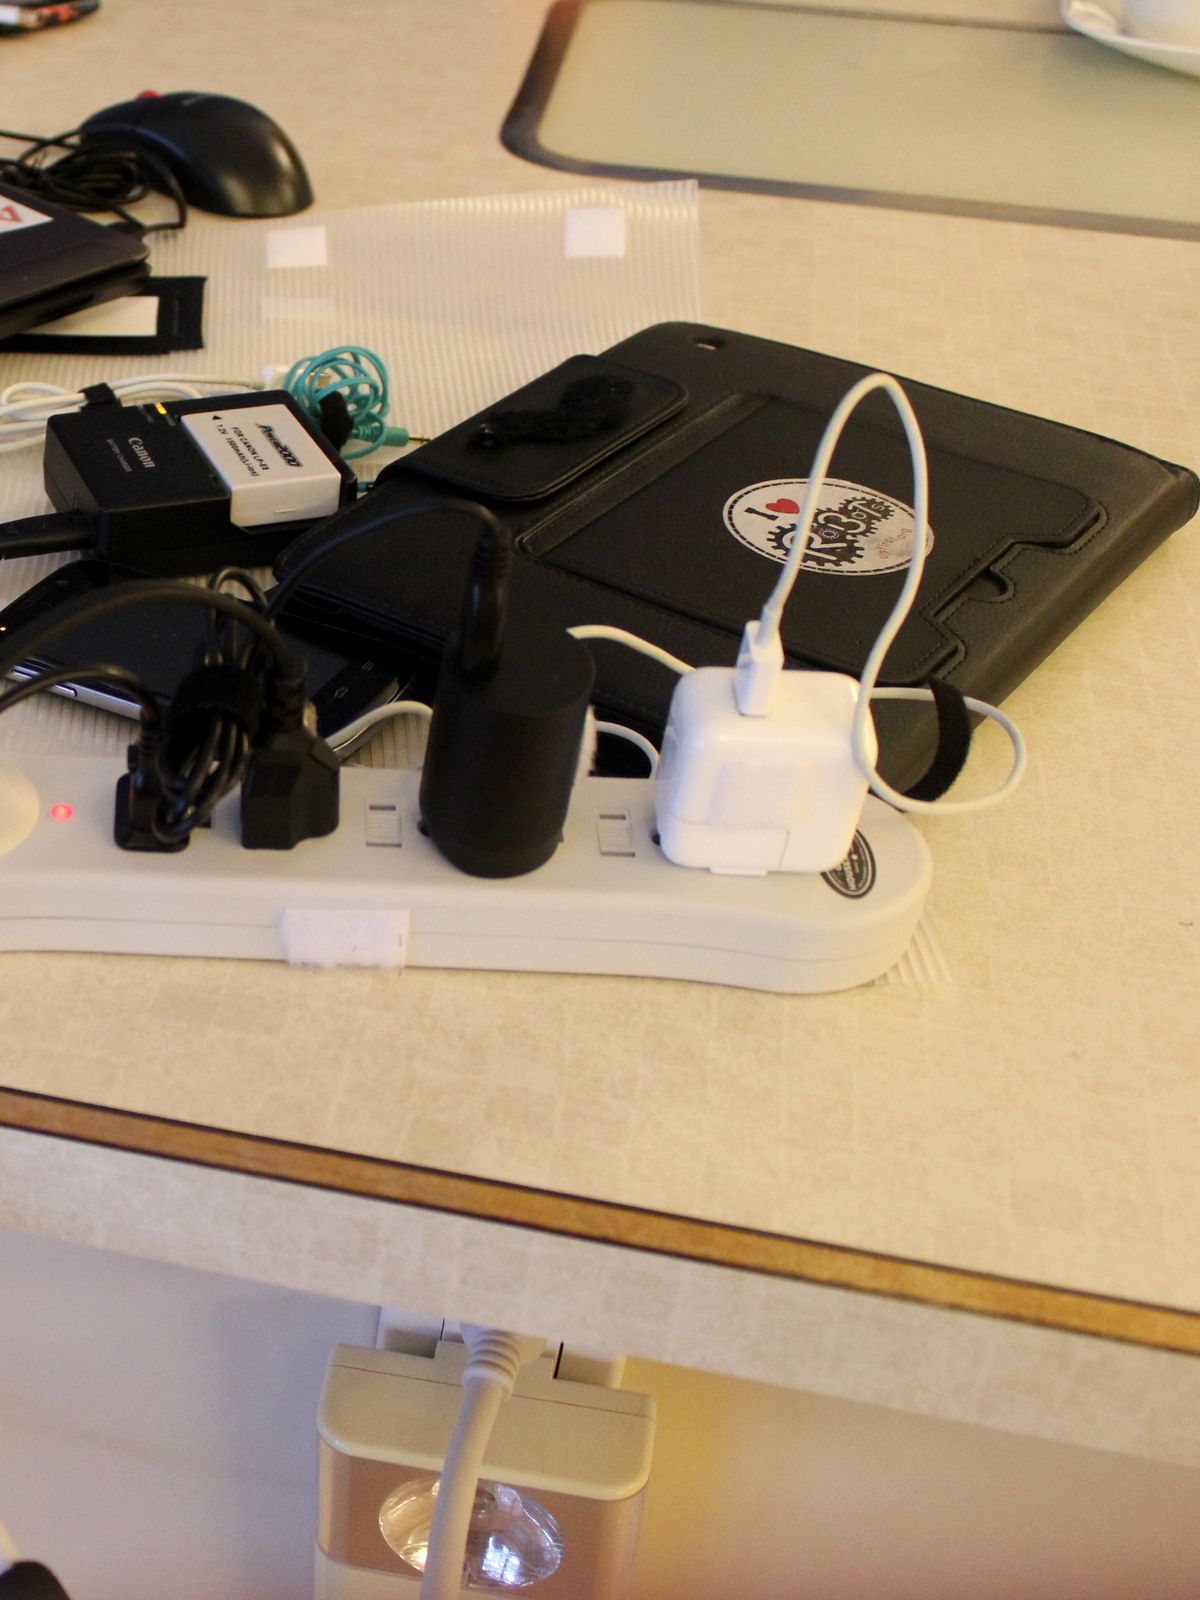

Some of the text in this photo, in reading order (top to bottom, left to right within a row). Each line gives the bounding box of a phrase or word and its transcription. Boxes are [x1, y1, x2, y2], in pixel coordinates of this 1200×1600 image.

[128, 437, 156, 468] Canon
[240, 437, 257, 456] CANON
[743, 506, 780, 521] I
